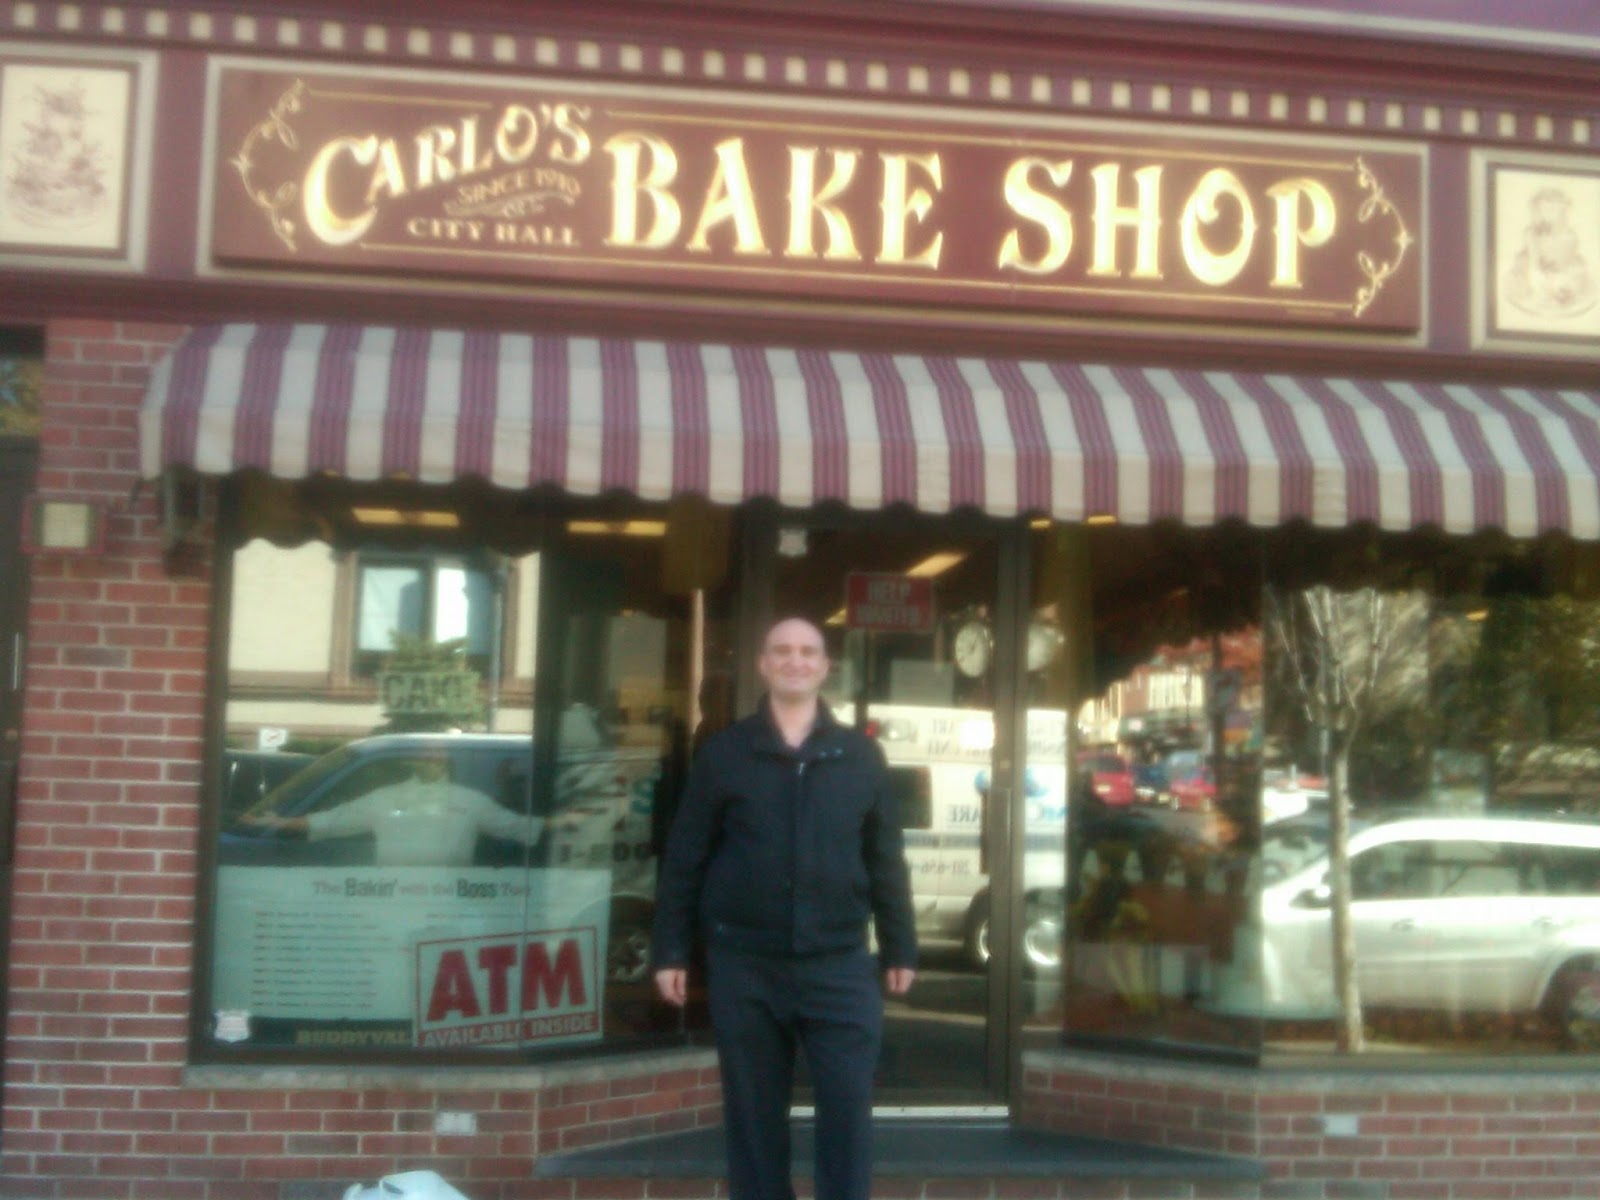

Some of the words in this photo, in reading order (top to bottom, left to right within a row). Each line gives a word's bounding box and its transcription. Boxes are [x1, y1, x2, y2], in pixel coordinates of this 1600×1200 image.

[303, 102, 592, 246] CARLO'S
[602, 130, 944, 270] BAKE
[997, 156, 1338, 289] SHOP
[457, 170, 529, 203] SINCE
[407, 218, 484, 241] CITY
[495, 222, 580, 248] HALL
[344, 876, 398, 898] Bakin'
[456, 877, 498, 898] Boss
[426, 938, 588, 1024] ATM
[422, 1021, 523, 1048] AVAILABLE
[531, 1013, 594, 1037] INSIDE
